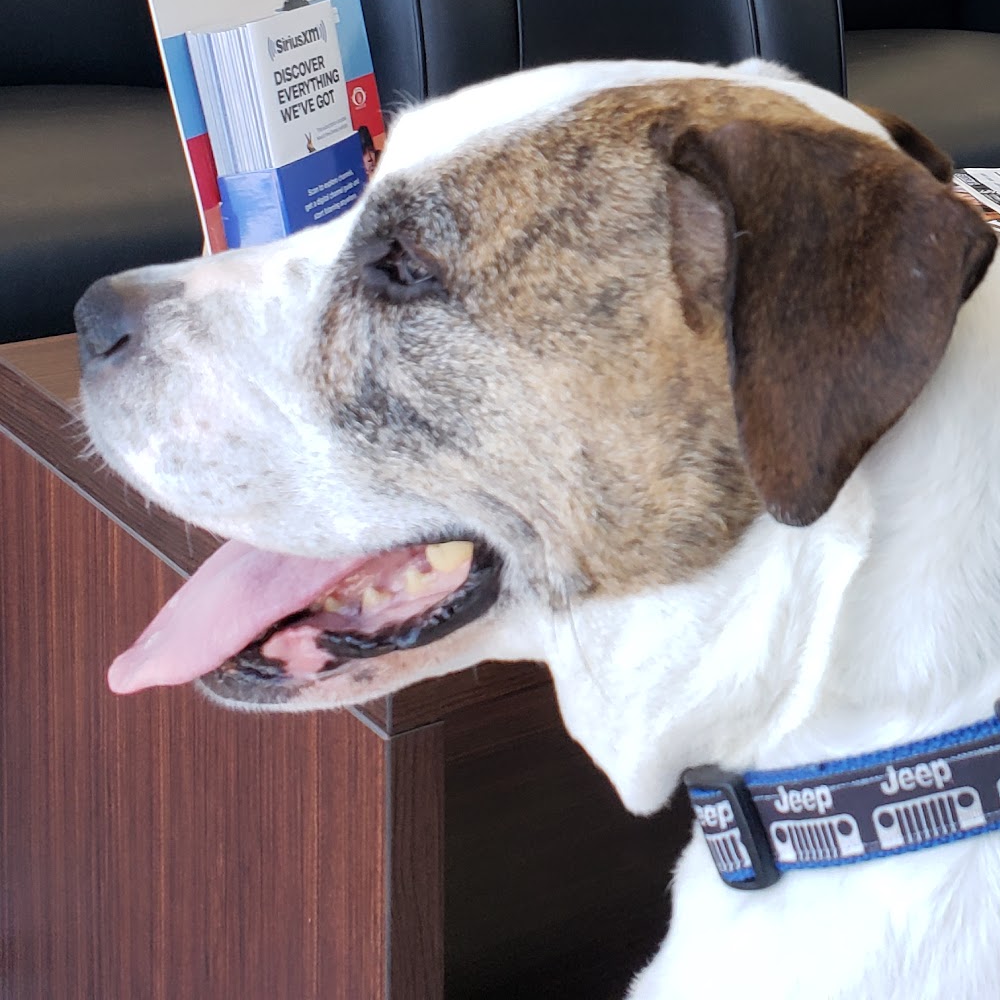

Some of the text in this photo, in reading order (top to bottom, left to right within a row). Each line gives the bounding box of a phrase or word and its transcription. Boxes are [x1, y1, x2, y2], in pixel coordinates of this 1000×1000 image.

[274, 56, 325, 86] DISCOVER
[277, 69, 340, 105] EVERYTHING
[281, 90, 335, 124] WE'VE GOT
[880, 758, 952, 795] Jeep
[774, 785, 833, 814] Jeep
